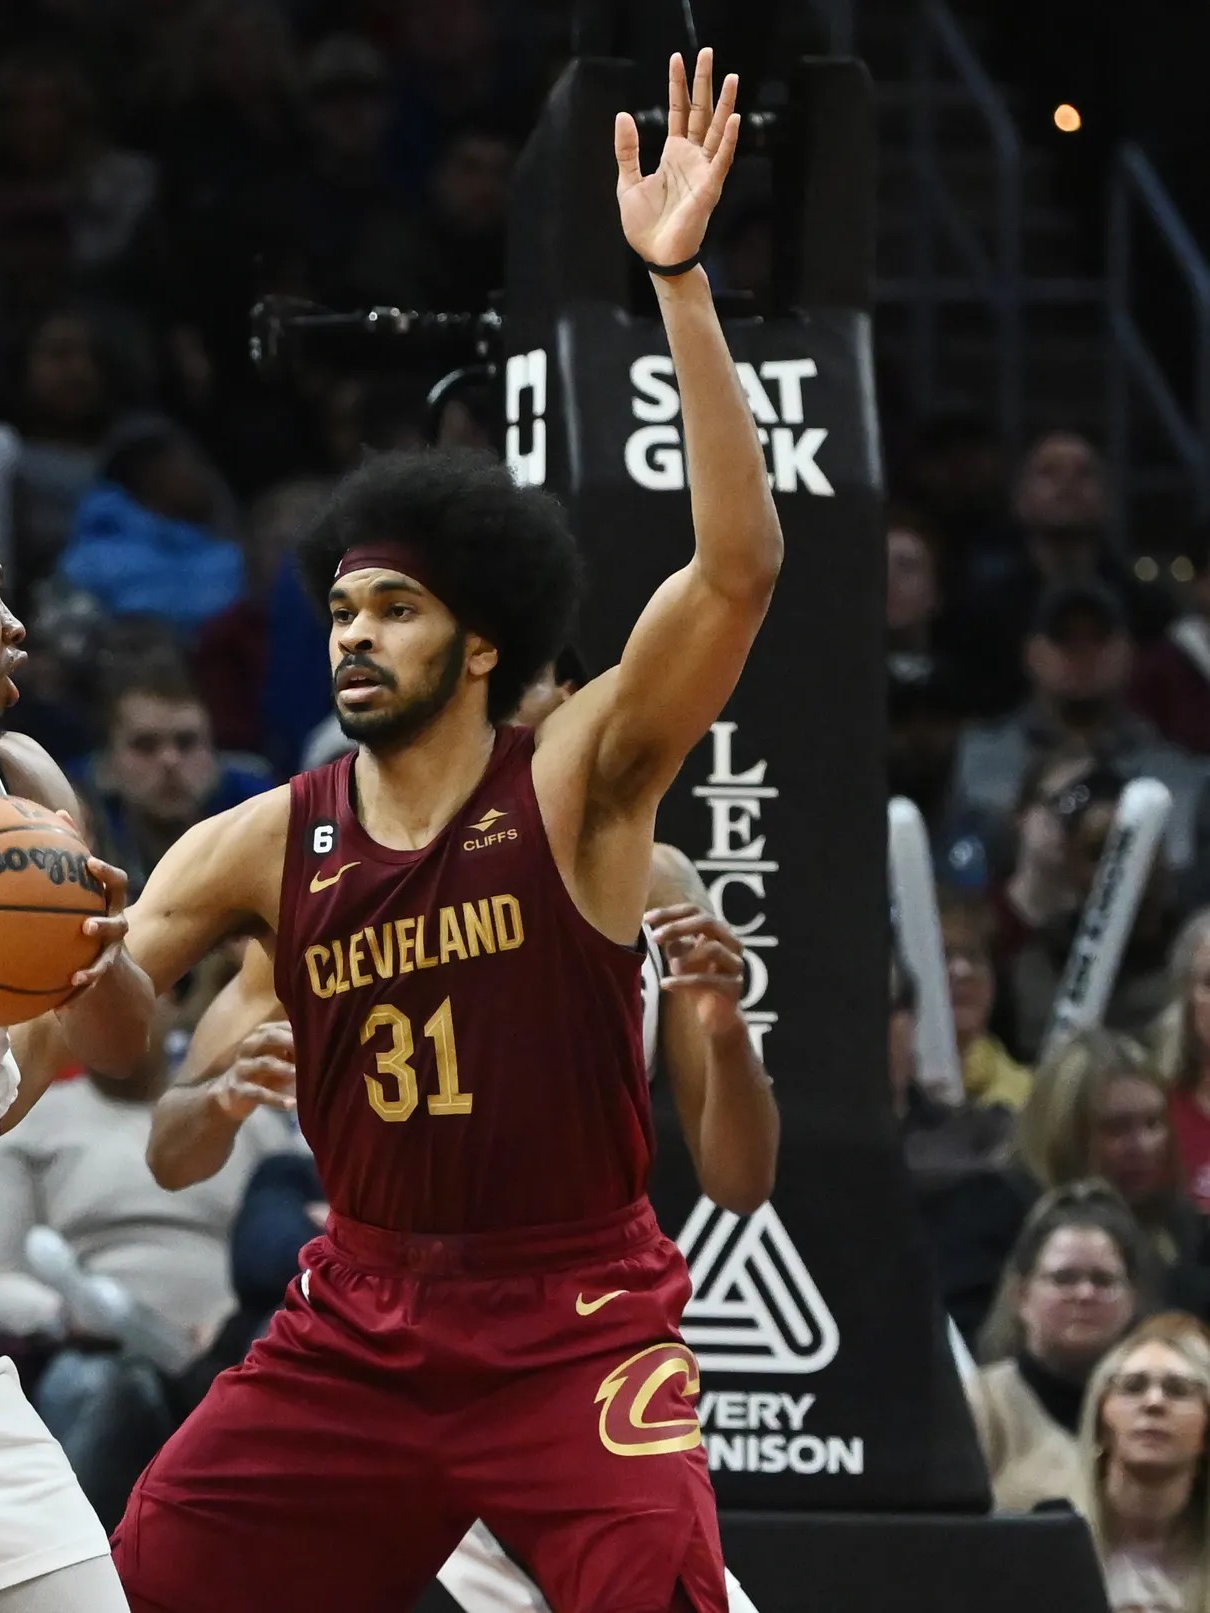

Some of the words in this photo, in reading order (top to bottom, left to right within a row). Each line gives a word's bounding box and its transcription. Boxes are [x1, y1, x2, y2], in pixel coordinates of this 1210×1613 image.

[625, 425, 835, 497] GK
[313, 825, 334, 853] 6
[463, 828, 518, 851] CLIFFS
[304, 893, 525, 999] CLEVELAND
[359, 995, 473, 1122] 31
[697, 1390, 816, 1431] VERY
[703, 1433, 864, 1475] NISON
